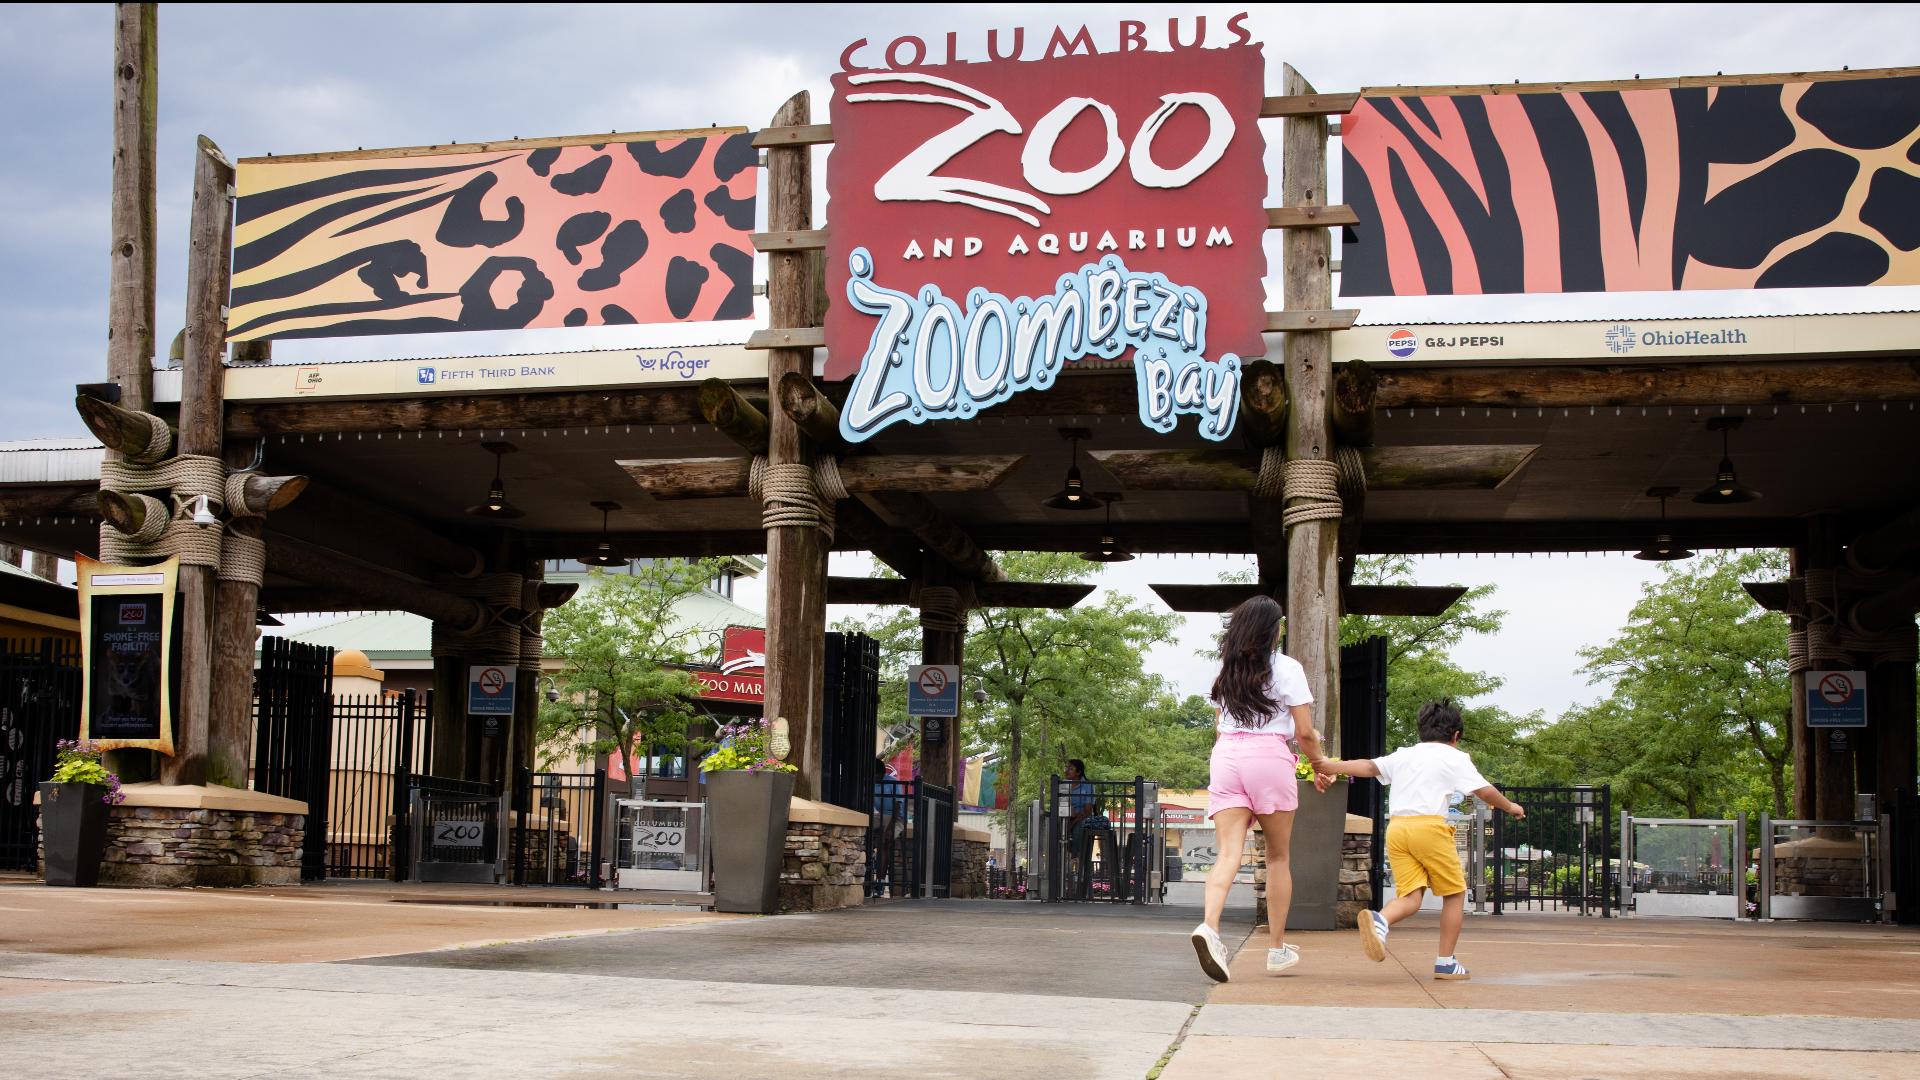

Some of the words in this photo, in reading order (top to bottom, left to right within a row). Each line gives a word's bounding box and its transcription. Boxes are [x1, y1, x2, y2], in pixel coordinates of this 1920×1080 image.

[839, 11, 1253, 73] COLUMBUS
[845, 72, 1237, 228] ZOO
[902, 237, 984, 261] AND
[1007, 225, 1235, 256] AQUARIUM
[1390, 339, 1417, 347] PEPSI
[1425, 337, 1456, 348] G&J
[1459, 336, 1504, 347] PEPSI
[1641, 328, 1748, 346] OhioHealth
[441, 369, 475, 380] FIFTH
[479, 367, 517, 379] THIRD
[520, 366, 557, 376] BANK
[660, 350, 711, 379] Kroger
[103, 632, 160, 642] SMOKE-FREE
[733, 681, 765, 695] MAR
[436, 822, 480, 843] ZOO
[634, 827, 683, 850] ZOO
